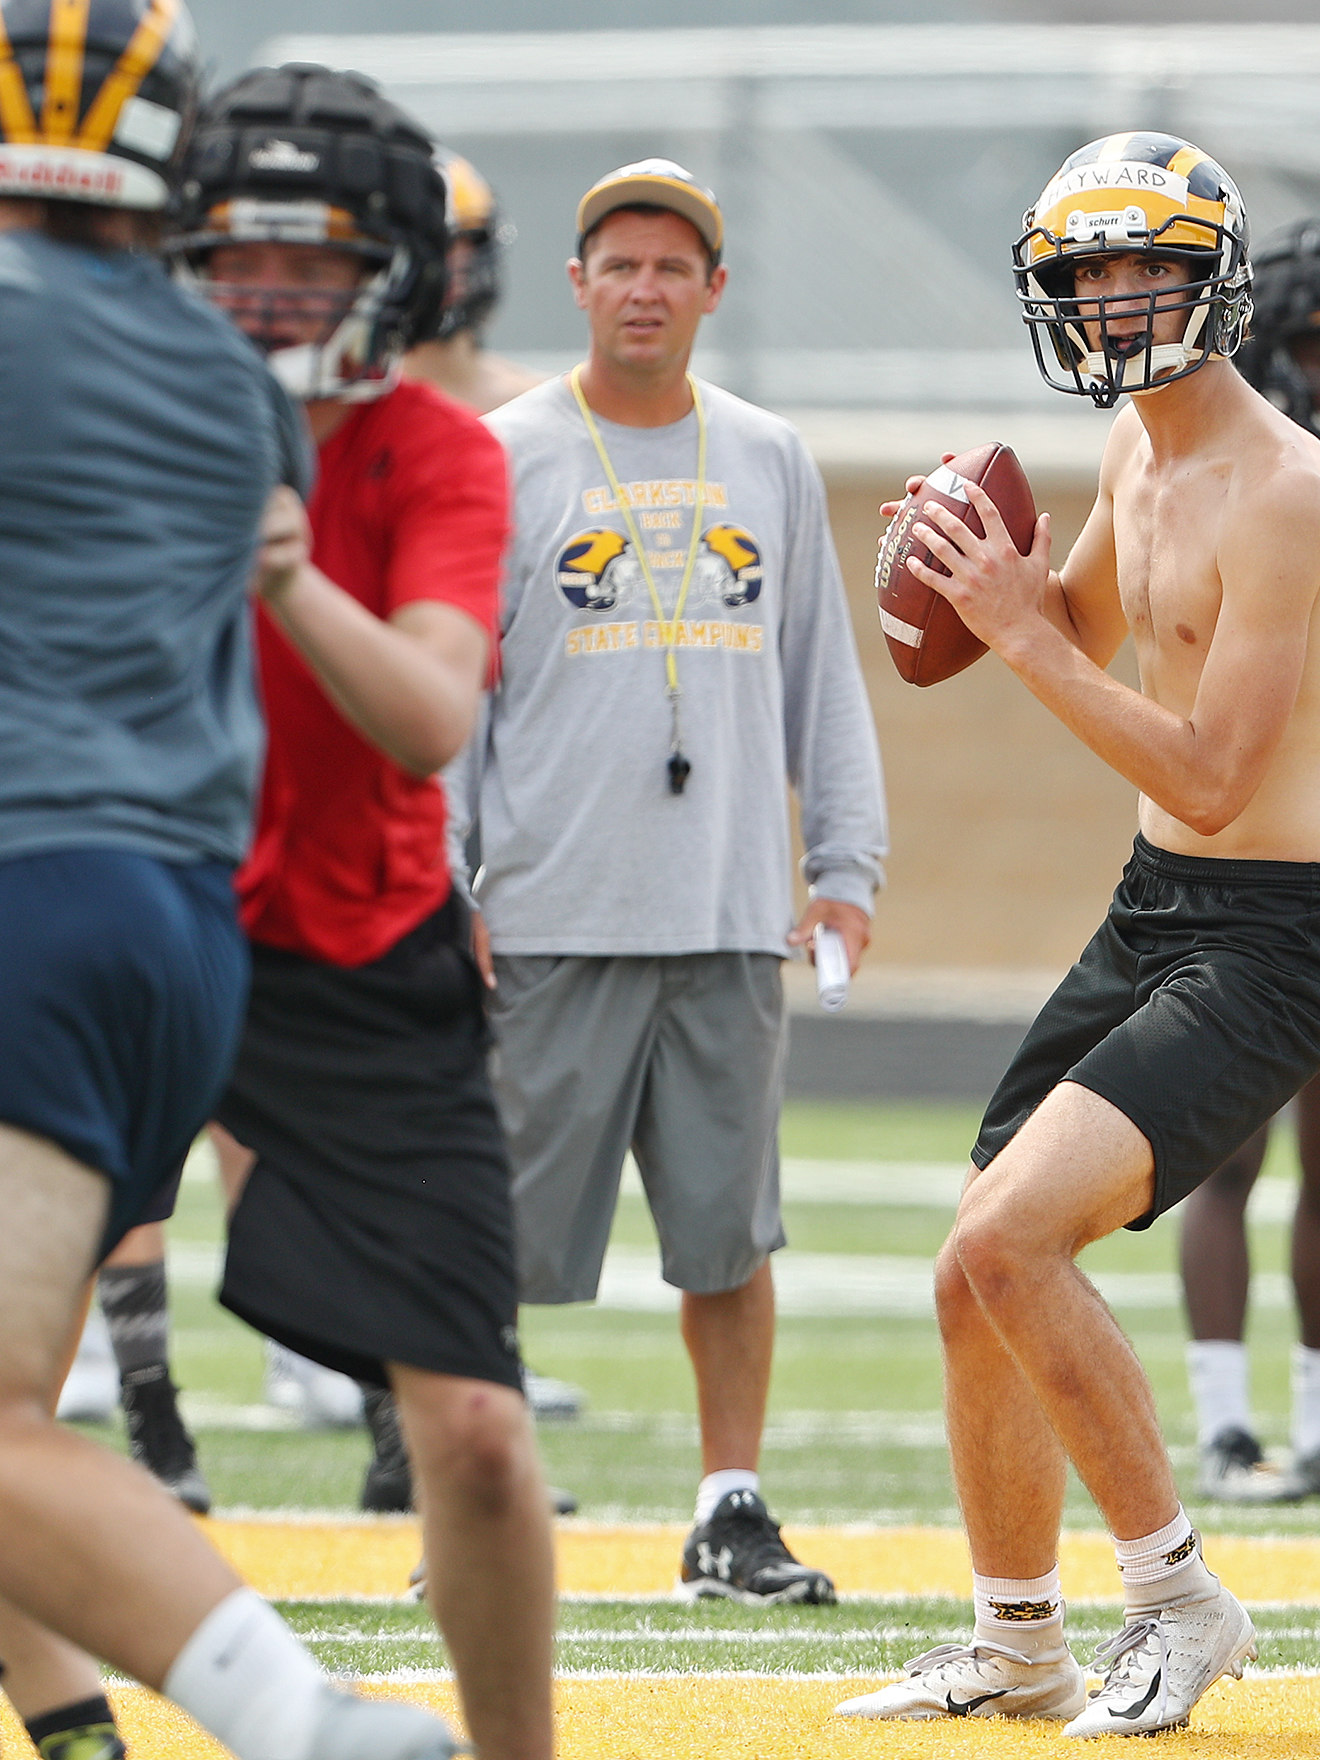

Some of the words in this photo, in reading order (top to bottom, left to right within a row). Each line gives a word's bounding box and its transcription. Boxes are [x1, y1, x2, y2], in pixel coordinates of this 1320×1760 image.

[1088, 216, 1119, 227] schutt
[880, 506, 917, 589] Wilson
[642, 618, 765, 653] CAMPIONS
